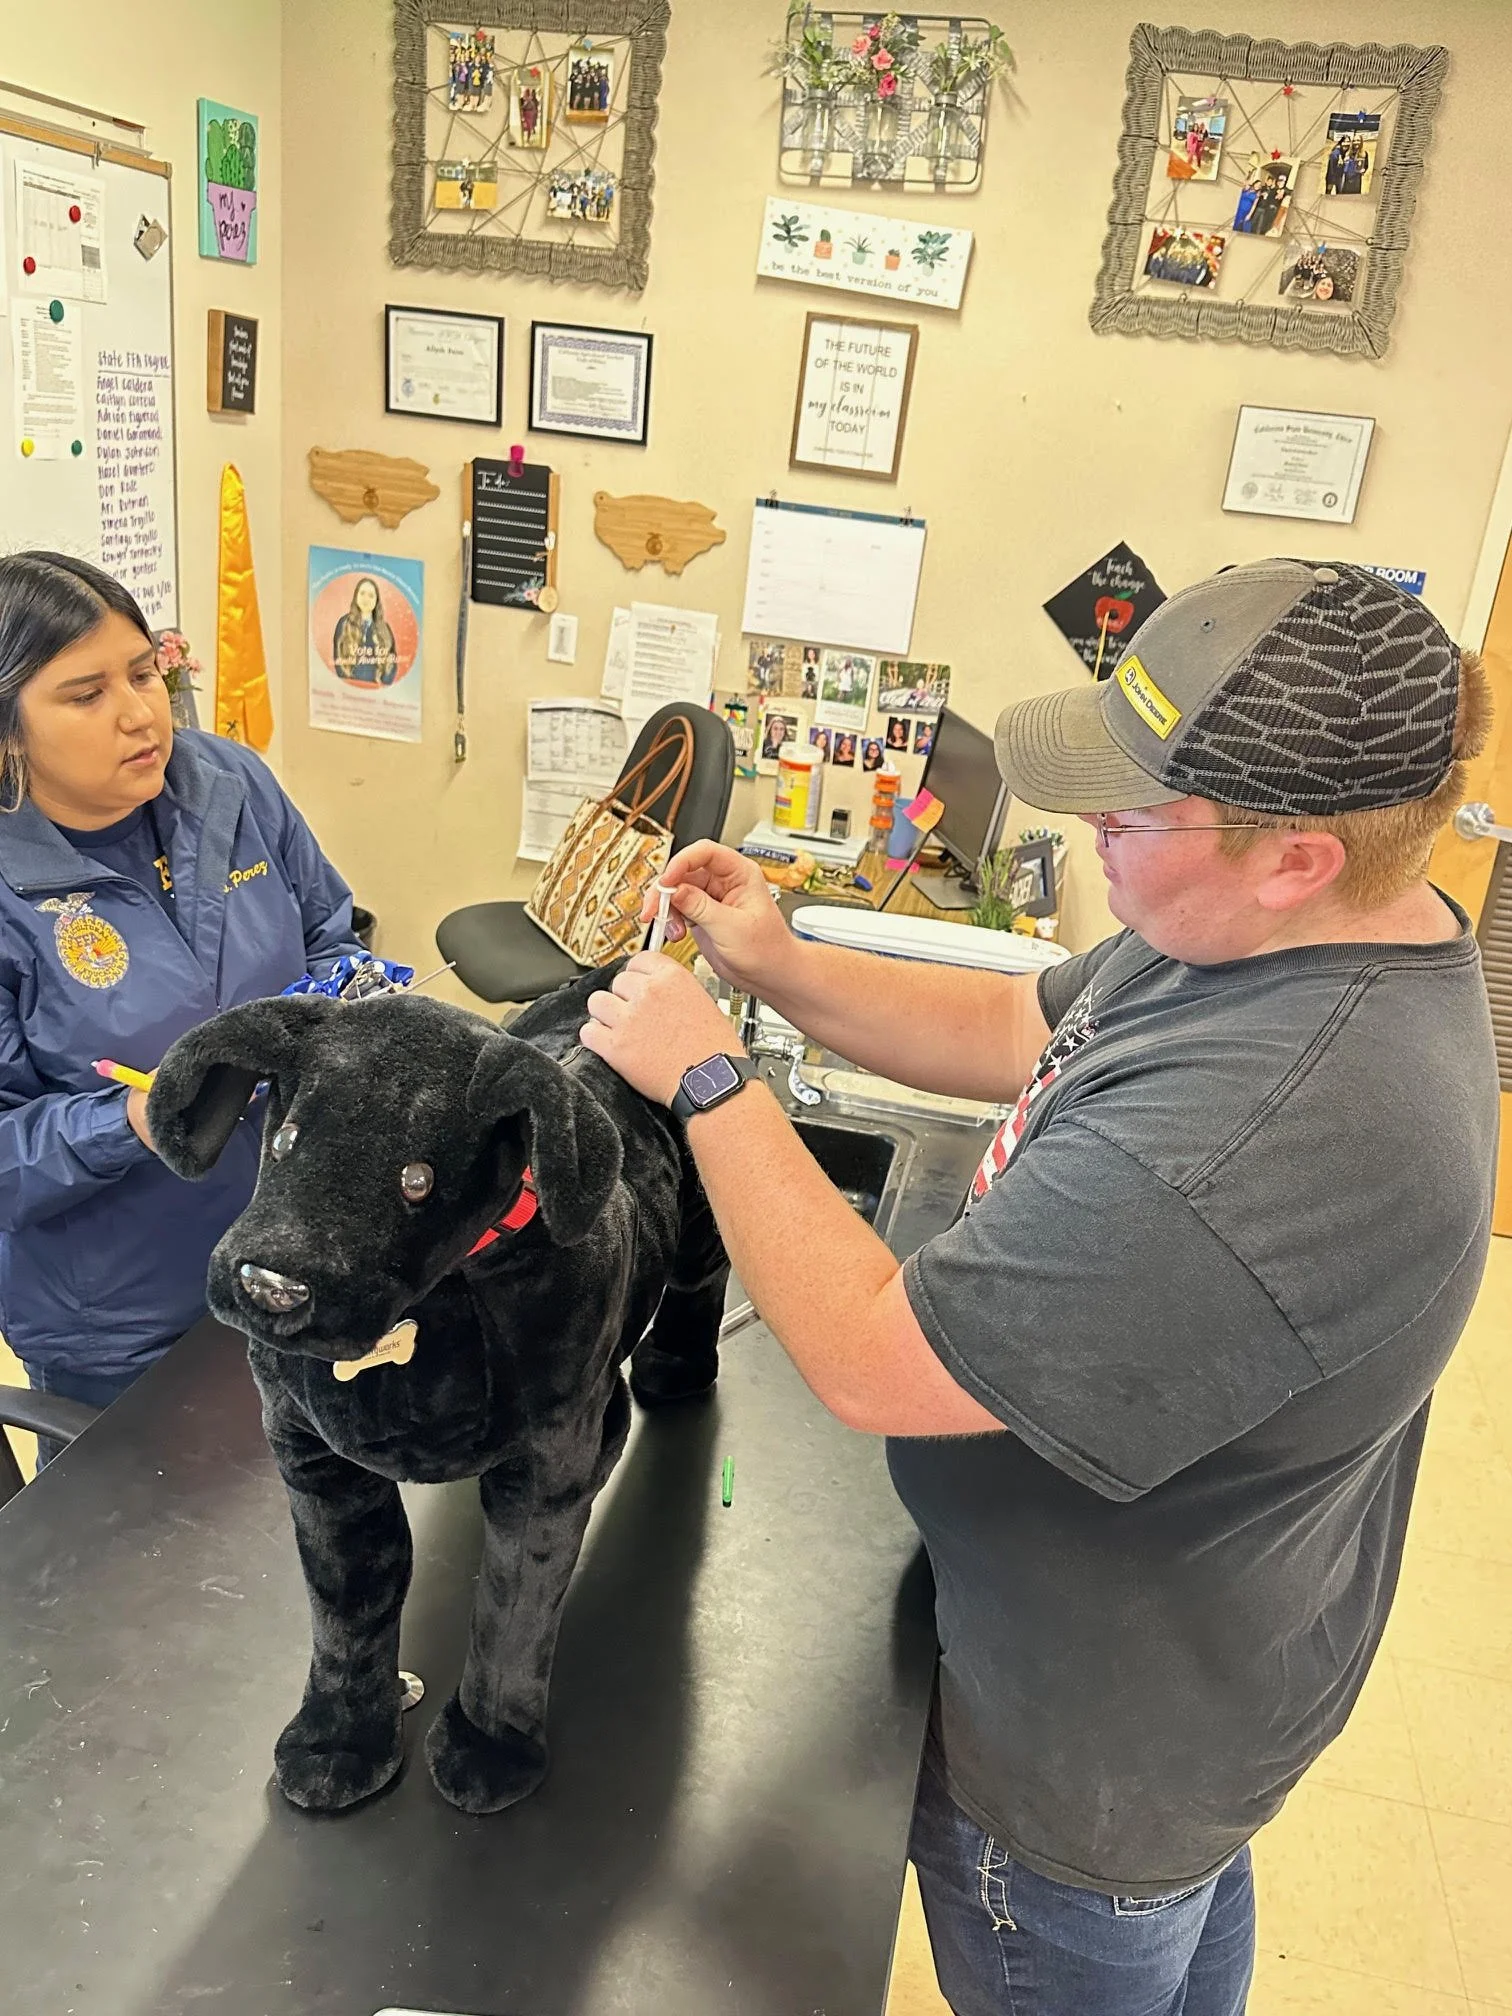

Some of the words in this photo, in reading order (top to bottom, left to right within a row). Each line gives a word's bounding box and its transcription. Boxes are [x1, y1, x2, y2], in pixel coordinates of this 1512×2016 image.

[772, 261, 785, 272] be
[791, 262, 809, 275] the
[816, 268, 841, 281] best
[848, 275, 891, 290] version
[898, 283, 911, 292] of
[916, 287, 938, 298] you
[825, 339, 845, 353] THE
[848, 342, 891, 358] FUTURE
[98, 350, 123, 367] State
[126, 352, 142, 368] FFA
[815, 358, 829, 369] OF
[833, 360, 854, 374] THE
[857, 363, 897, 378] WORLD
[840, 382, 850, 393] IS
[853, 383, 865, 394] IN
[808, 399, 827, 418] my
[830, 395, 891, 419] classroom
[830, 421, 866, 434] TODAY
[1132, 683, 1148, 703] JOHN
[1145, 698, 1168, 726] DEERE
[229, 861, 268, 889] Perez
